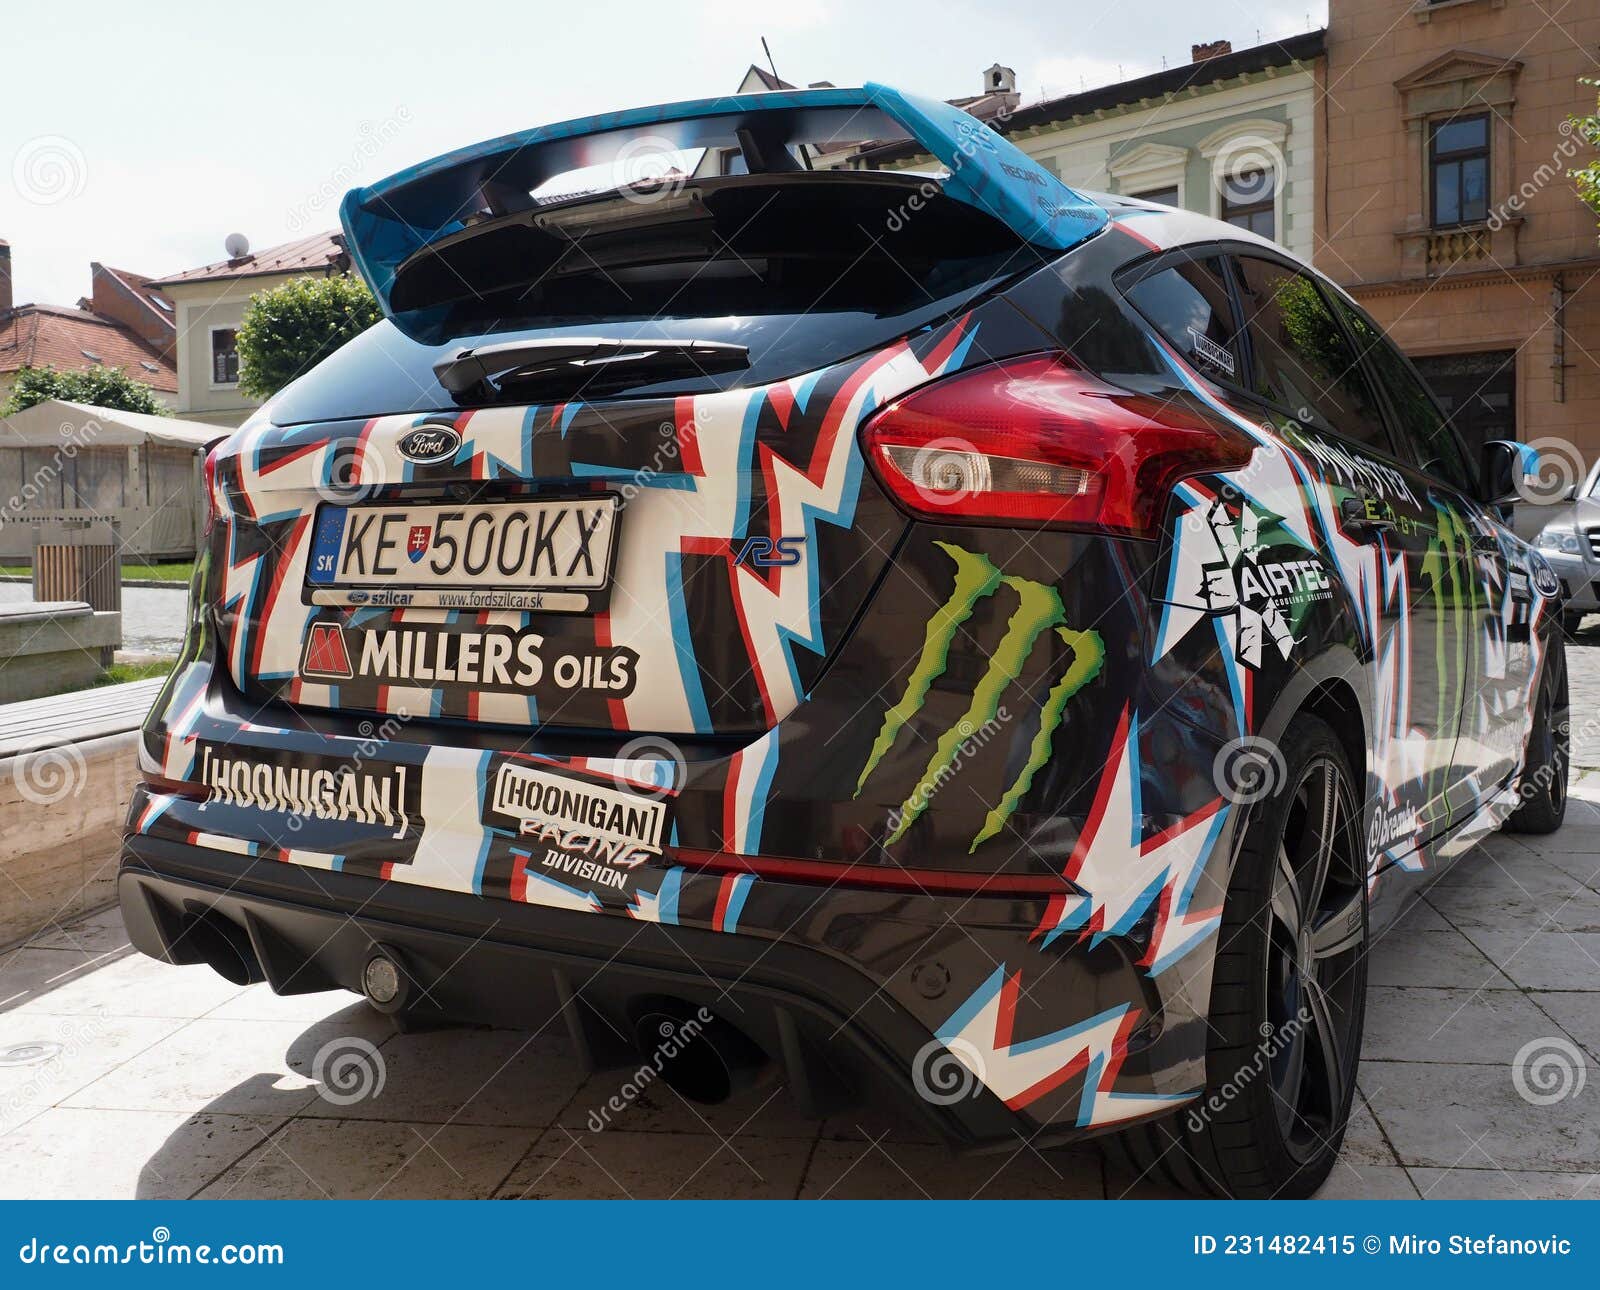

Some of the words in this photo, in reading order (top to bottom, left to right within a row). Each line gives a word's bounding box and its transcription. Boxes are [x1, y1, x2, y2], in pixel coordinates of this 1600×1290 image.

[409, 431, 446, 455] Ford
[316, 555, 333, 571] SK
[342, 513, 408, 575] KE
[430, 508, 604, 577] 500KX
[733, 535, 808, 567] RS
[371, 590, 414, 605] szilcar
[438, 592, 544, 609] www.fordszilcar.sk
[1241, 560, 1330, 602] AIRTEC
[359, 629, 545, 687] MILLERS
[553, 655, 630, 690] OILS
[519, 817, 650, 869] RACING
[542, 849, 628, 890] DIVISION
